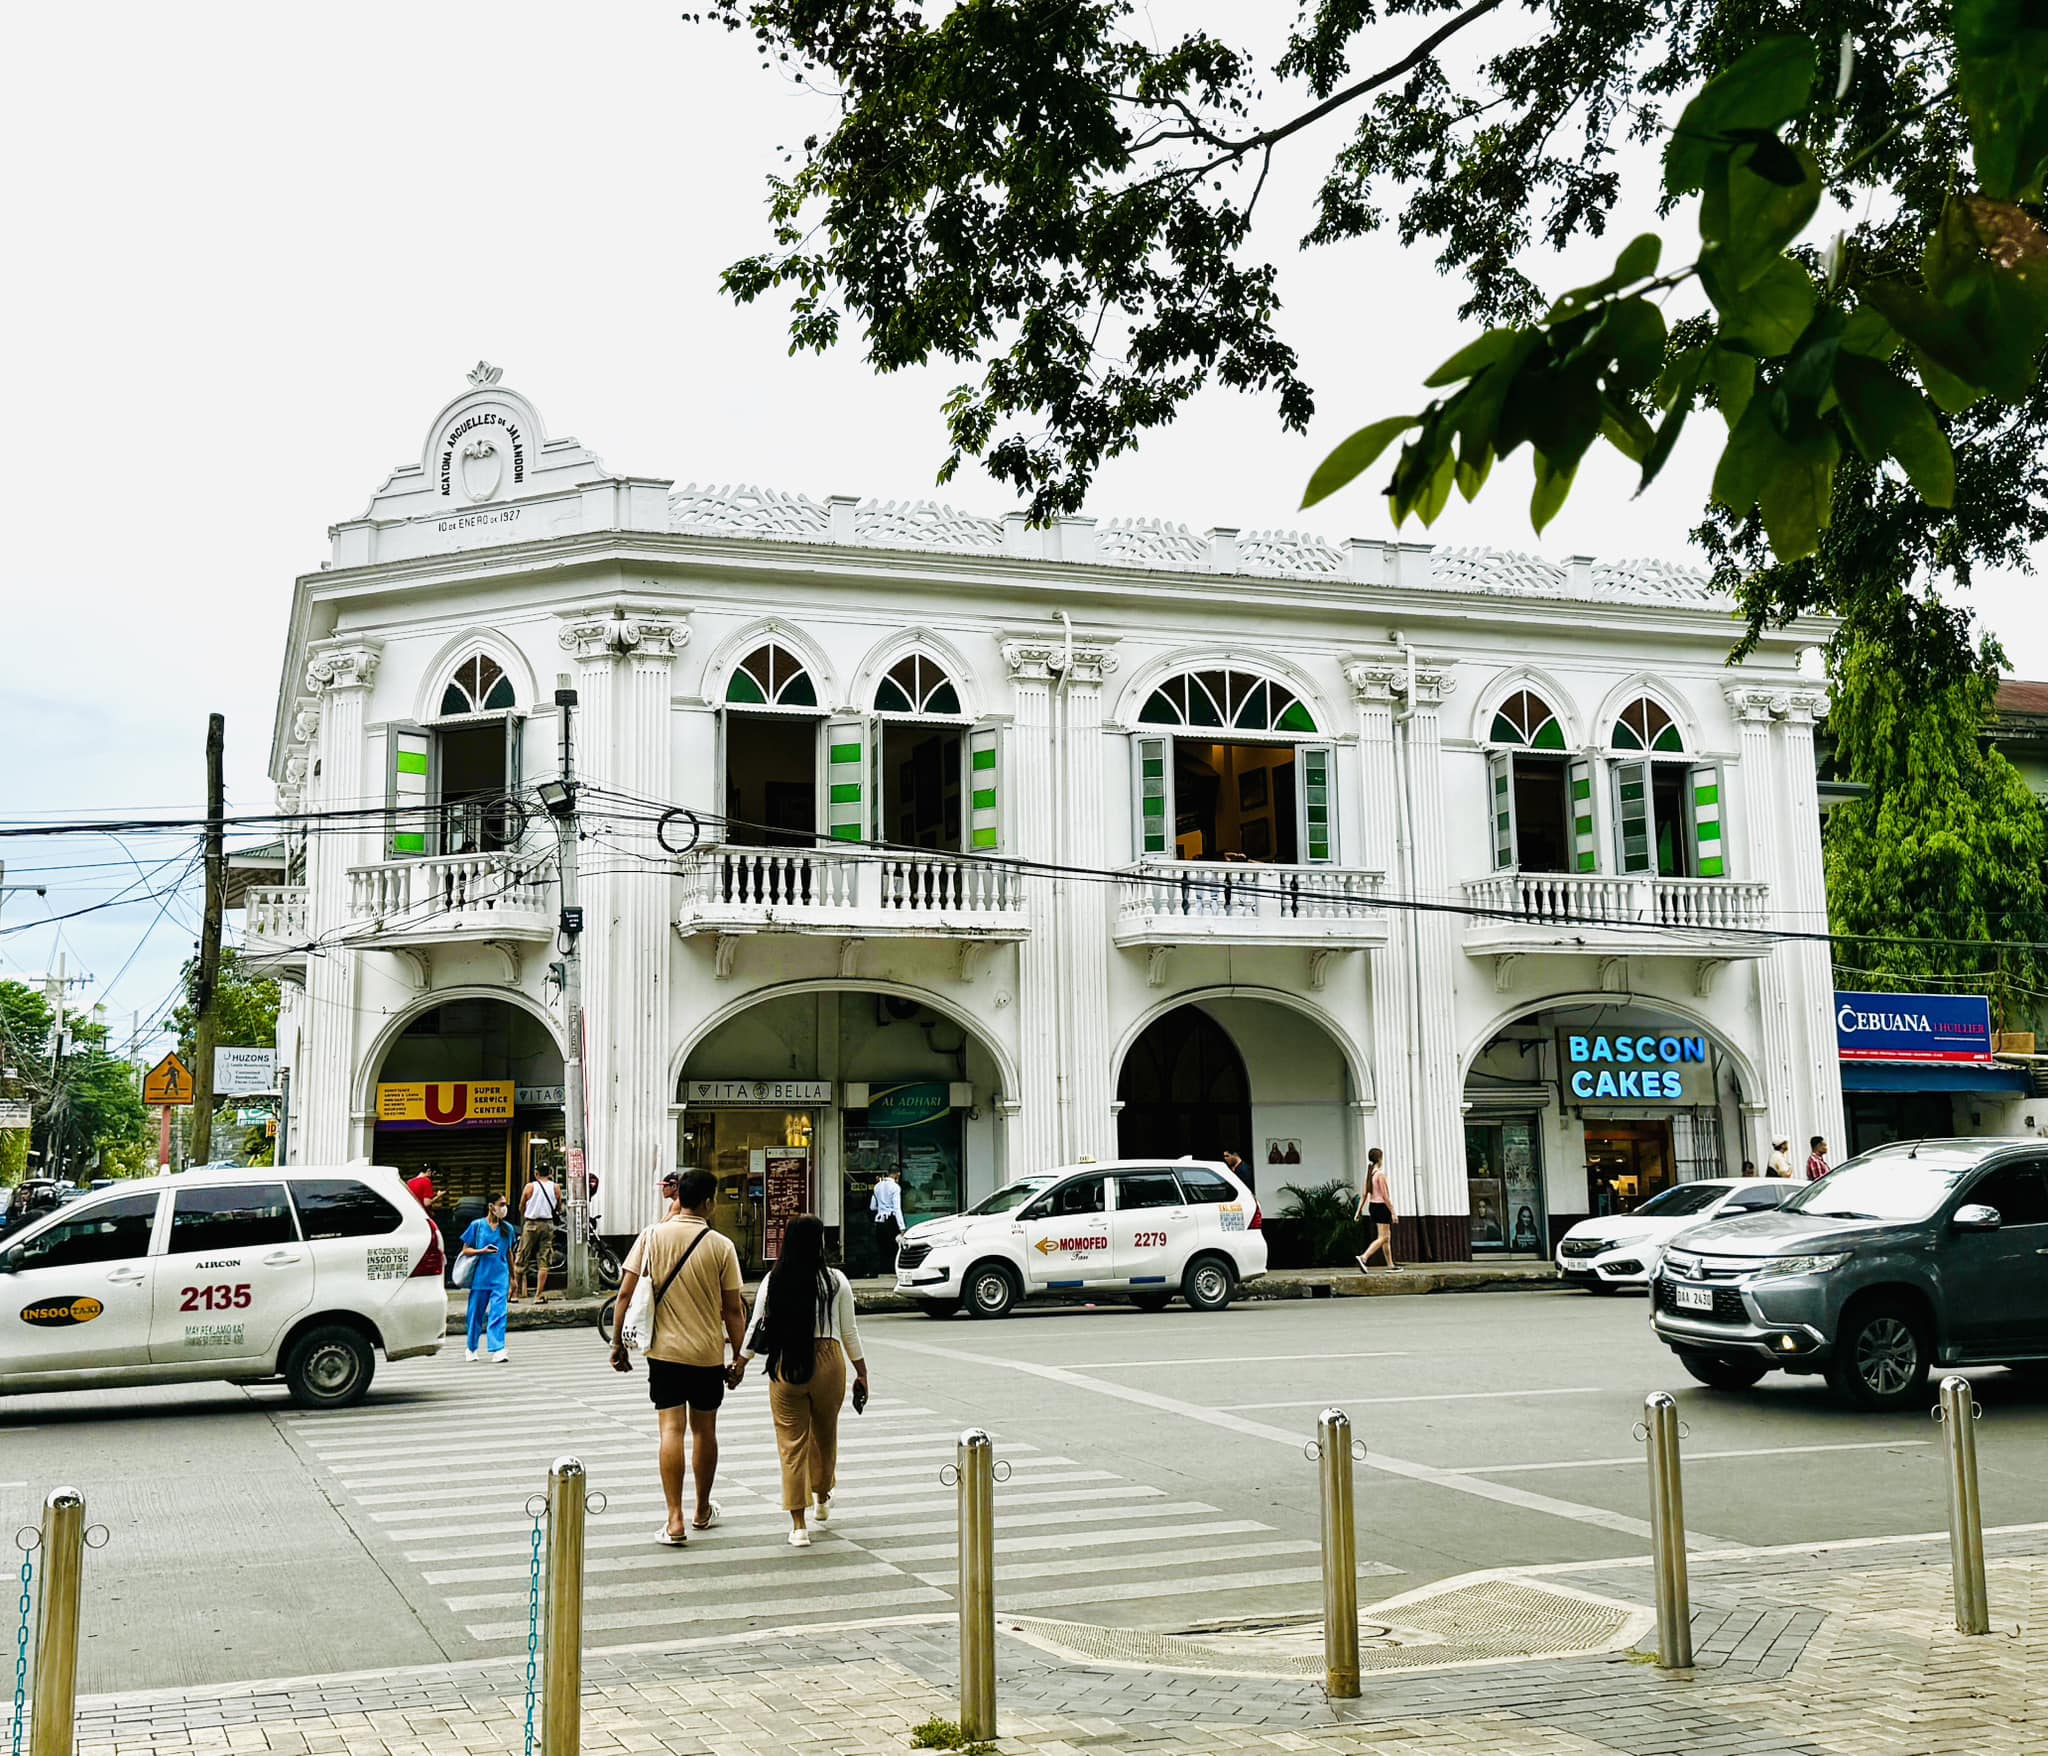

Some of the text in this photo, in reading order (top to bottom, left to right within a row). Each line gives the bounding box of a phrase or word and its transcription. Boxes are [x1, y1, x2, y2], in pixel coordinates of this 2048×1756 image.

[438, 521, 447, 532] 10
[458, 514, 489, 529] ENERO
[500, 509, 521, 522] 1927
[1838, 1004, 1932, 1032] CEBUANA
[1569, 1035, 1706, 1063] BASCON
[697, 1085, 822, 1098] VITA BELLA
[1571, 1070, 1684, 1098] CAKES
[425, 1084, 467, 1125] U
[474, 1096, 508, 1104] SERVICE
[474, 1106, 507, 1114] CENTER
[1060, 1237, 1108, 1251] MOMOFED
[1134, 1231, 1167, 1247] 2279
[195, 1260, 241, 1269] AIRCON
[179, 1284, 252, 1312] 2135
[23, 1307, 69, 1320] INSOO
